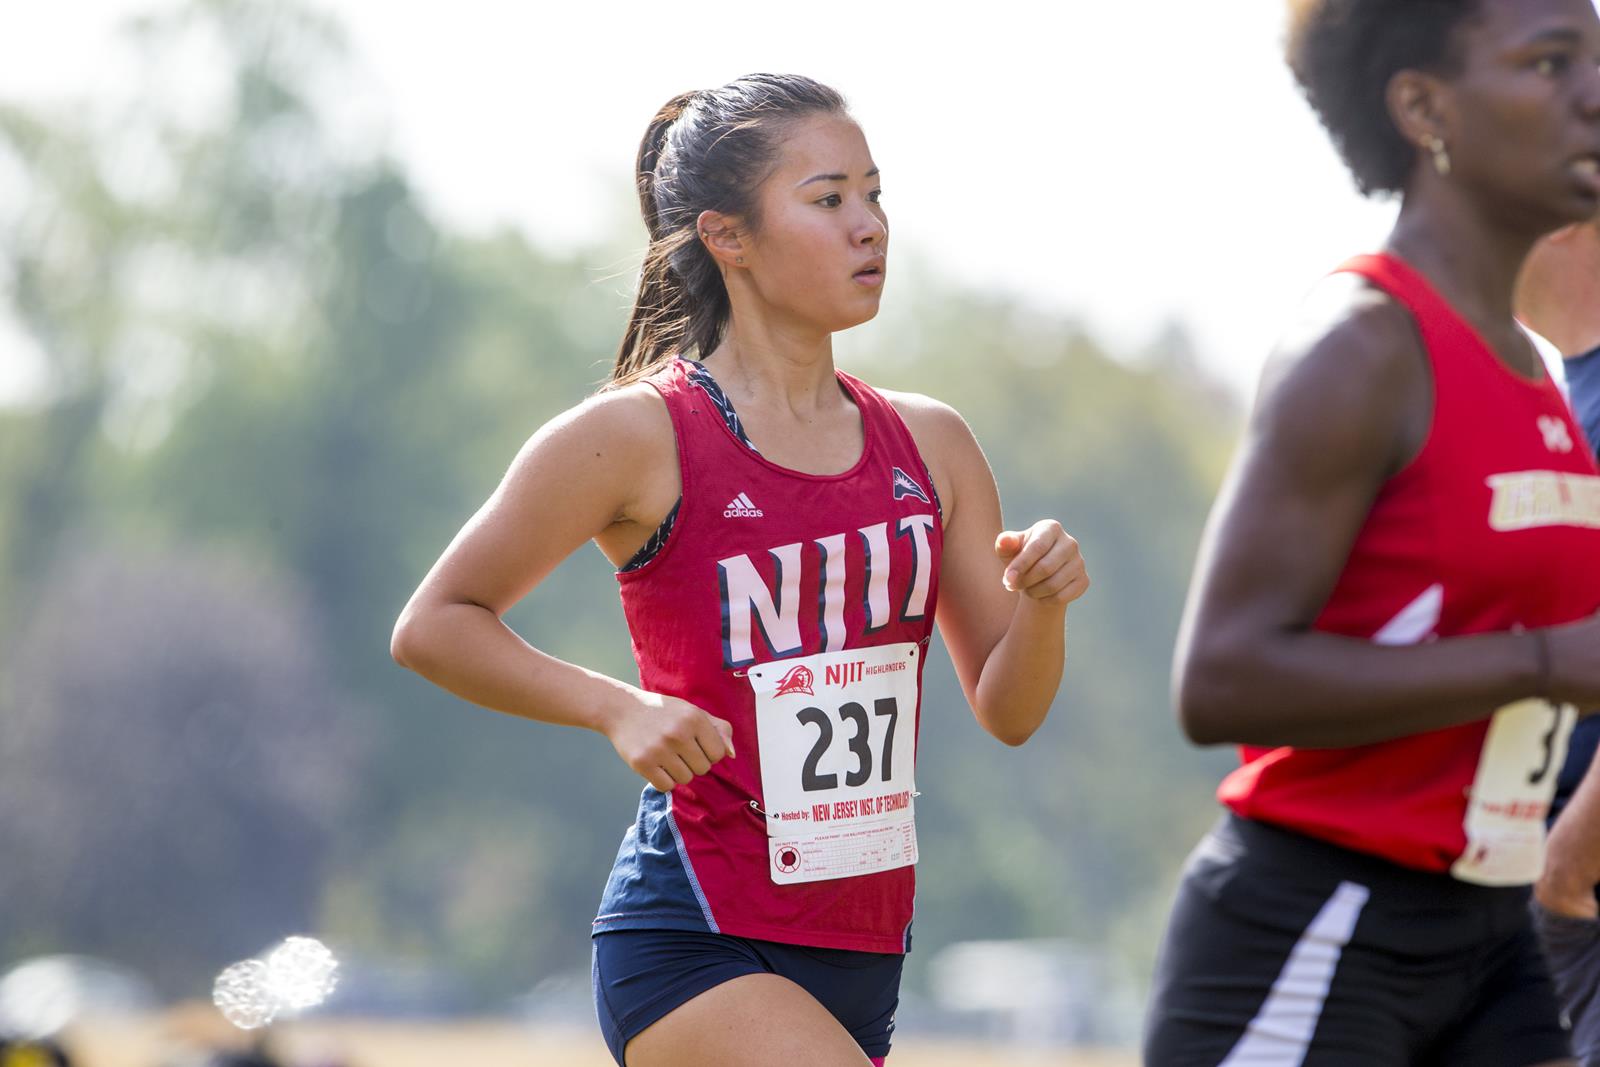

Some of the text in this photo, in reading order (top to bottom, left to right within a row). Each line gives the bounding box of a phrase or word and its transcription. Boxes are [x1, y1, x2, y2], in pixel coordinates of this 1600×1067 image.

[723, 507, 764, 518] adidas
[825, 661, 906, 690] NJIT HIGHLANDERS
[795, 697, 898, 792] 237
[781, 790, 910, 822] Hosted by: NEW JERSEY INST. OF TECHNOLOGY
